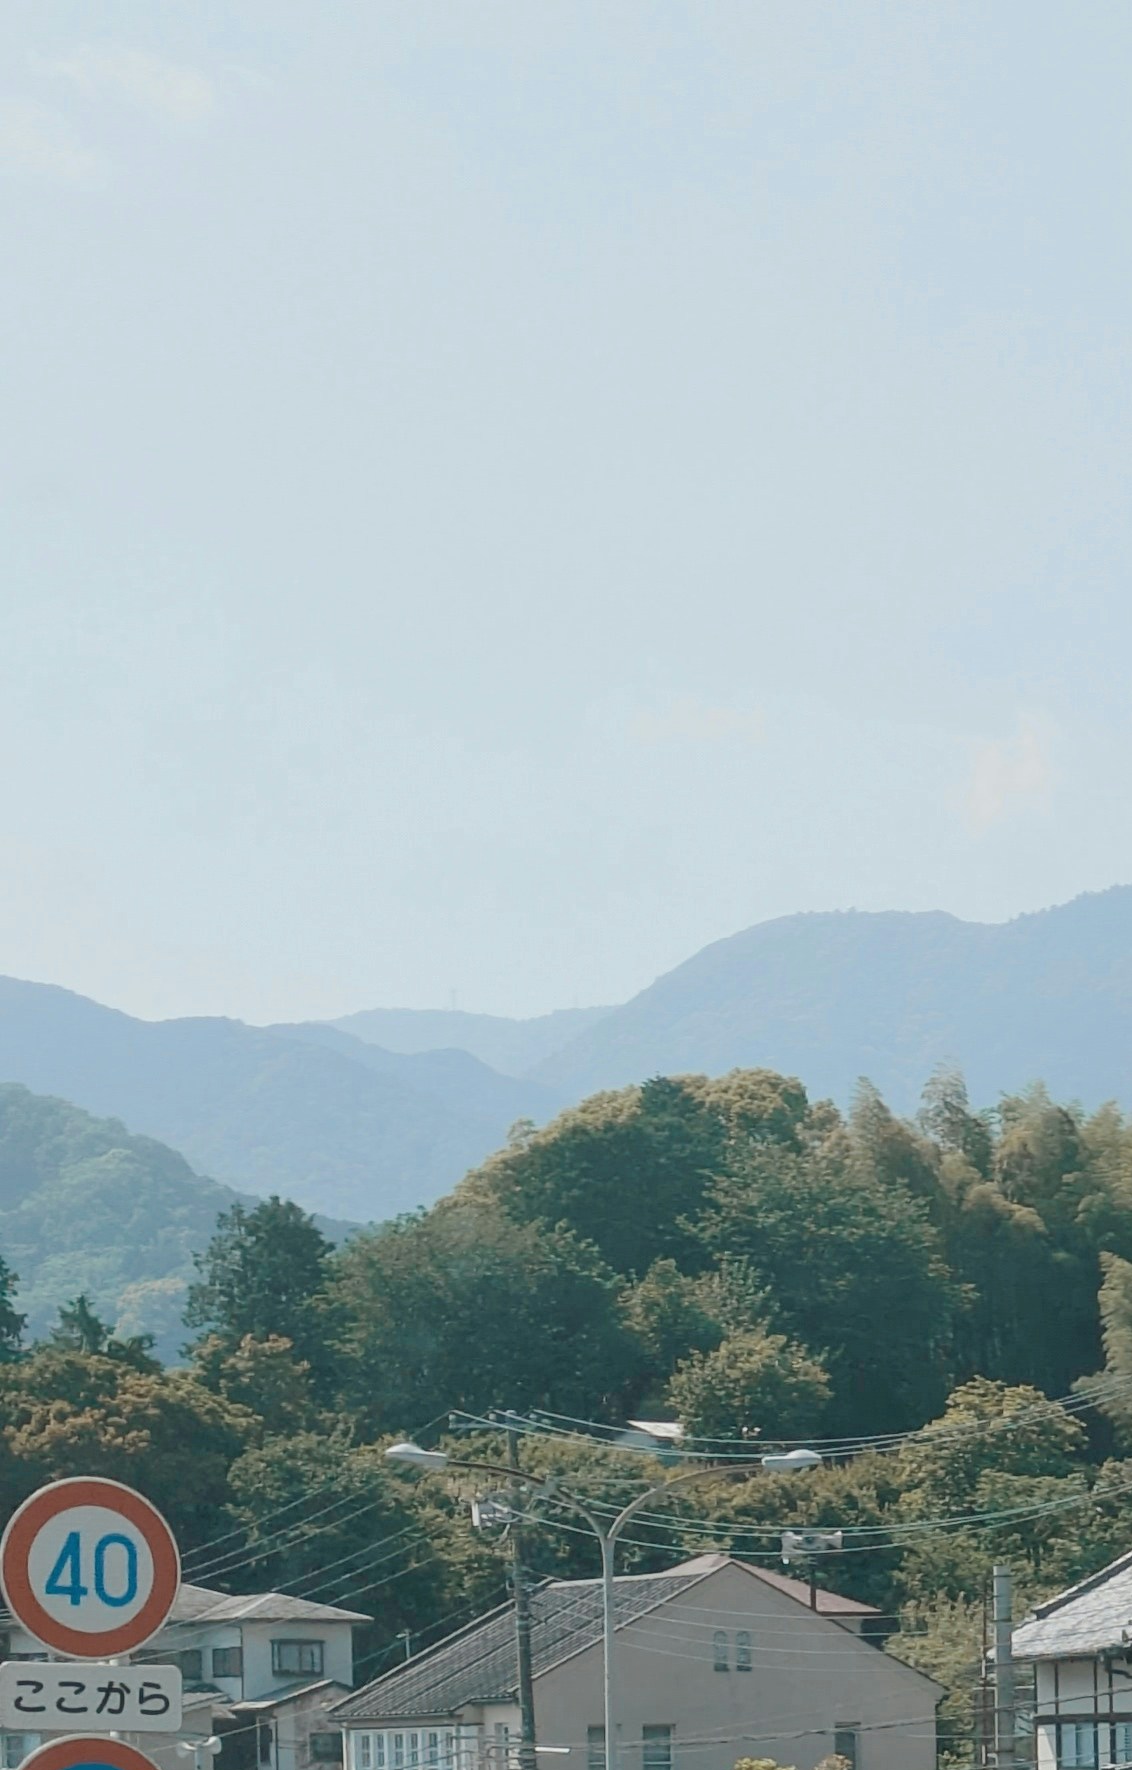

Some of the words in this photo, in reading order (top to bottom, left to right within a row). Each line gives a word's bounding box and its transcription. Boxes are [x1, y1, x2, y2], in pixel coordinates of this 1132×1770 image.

[45, 1531, 138, 1608] 40
[14, 1680, 171, 1716] ここから
